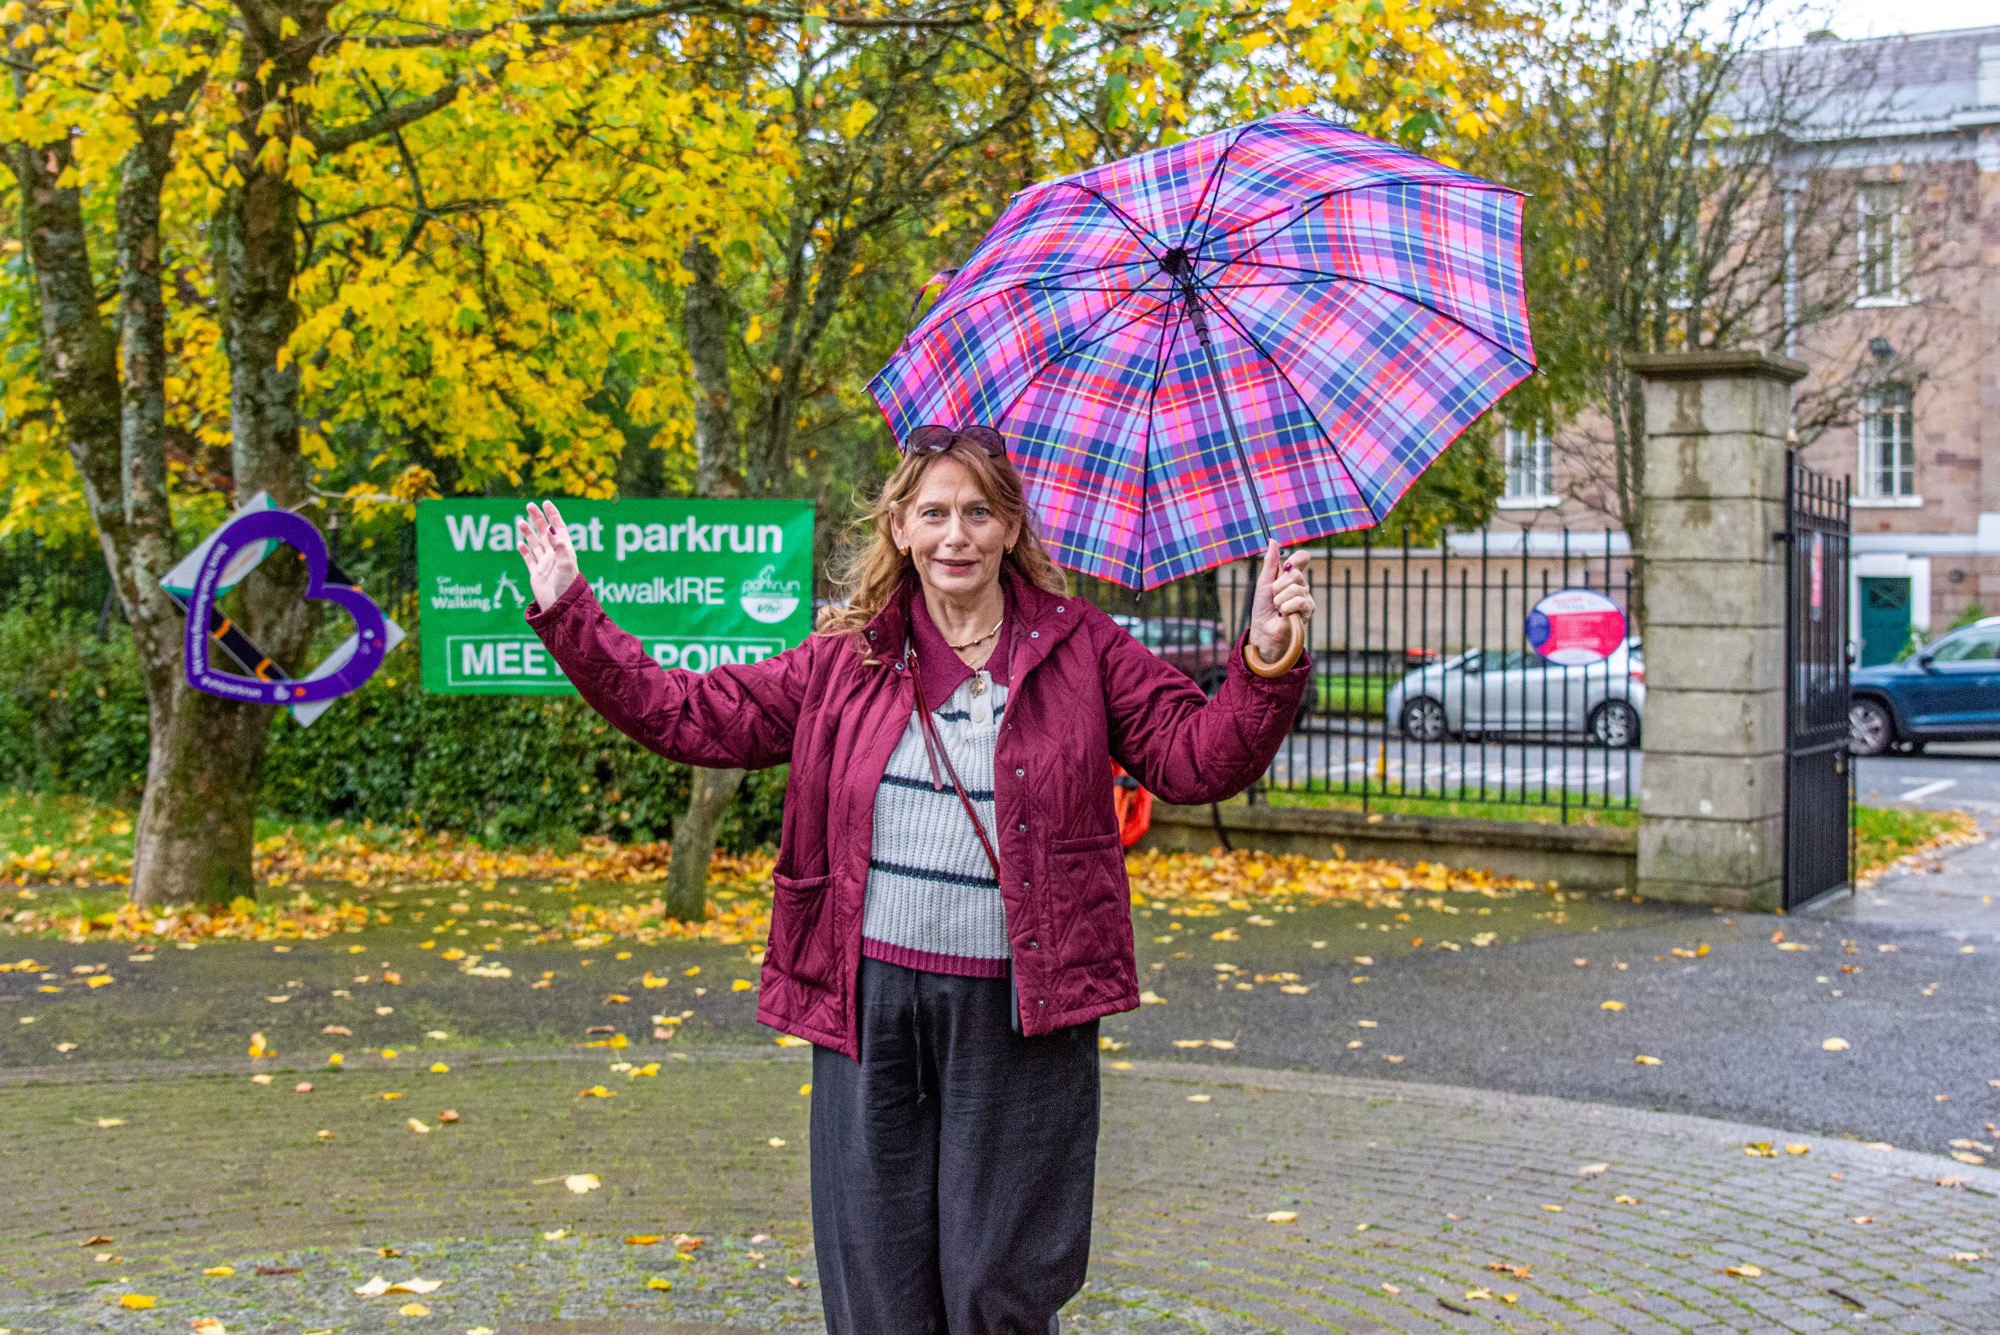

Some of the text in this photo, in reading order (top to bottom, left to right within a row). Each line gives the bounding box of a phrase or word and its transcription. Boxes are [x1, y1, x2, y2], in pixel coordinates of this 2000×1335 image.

[567, 517, 604, 552] at
[615, 515, 784, 561] parkrun
[439, 583, 482, 595] Ireland
[431, 596, 491, 612] Walking
[653, 643, 773, 675] POINT
